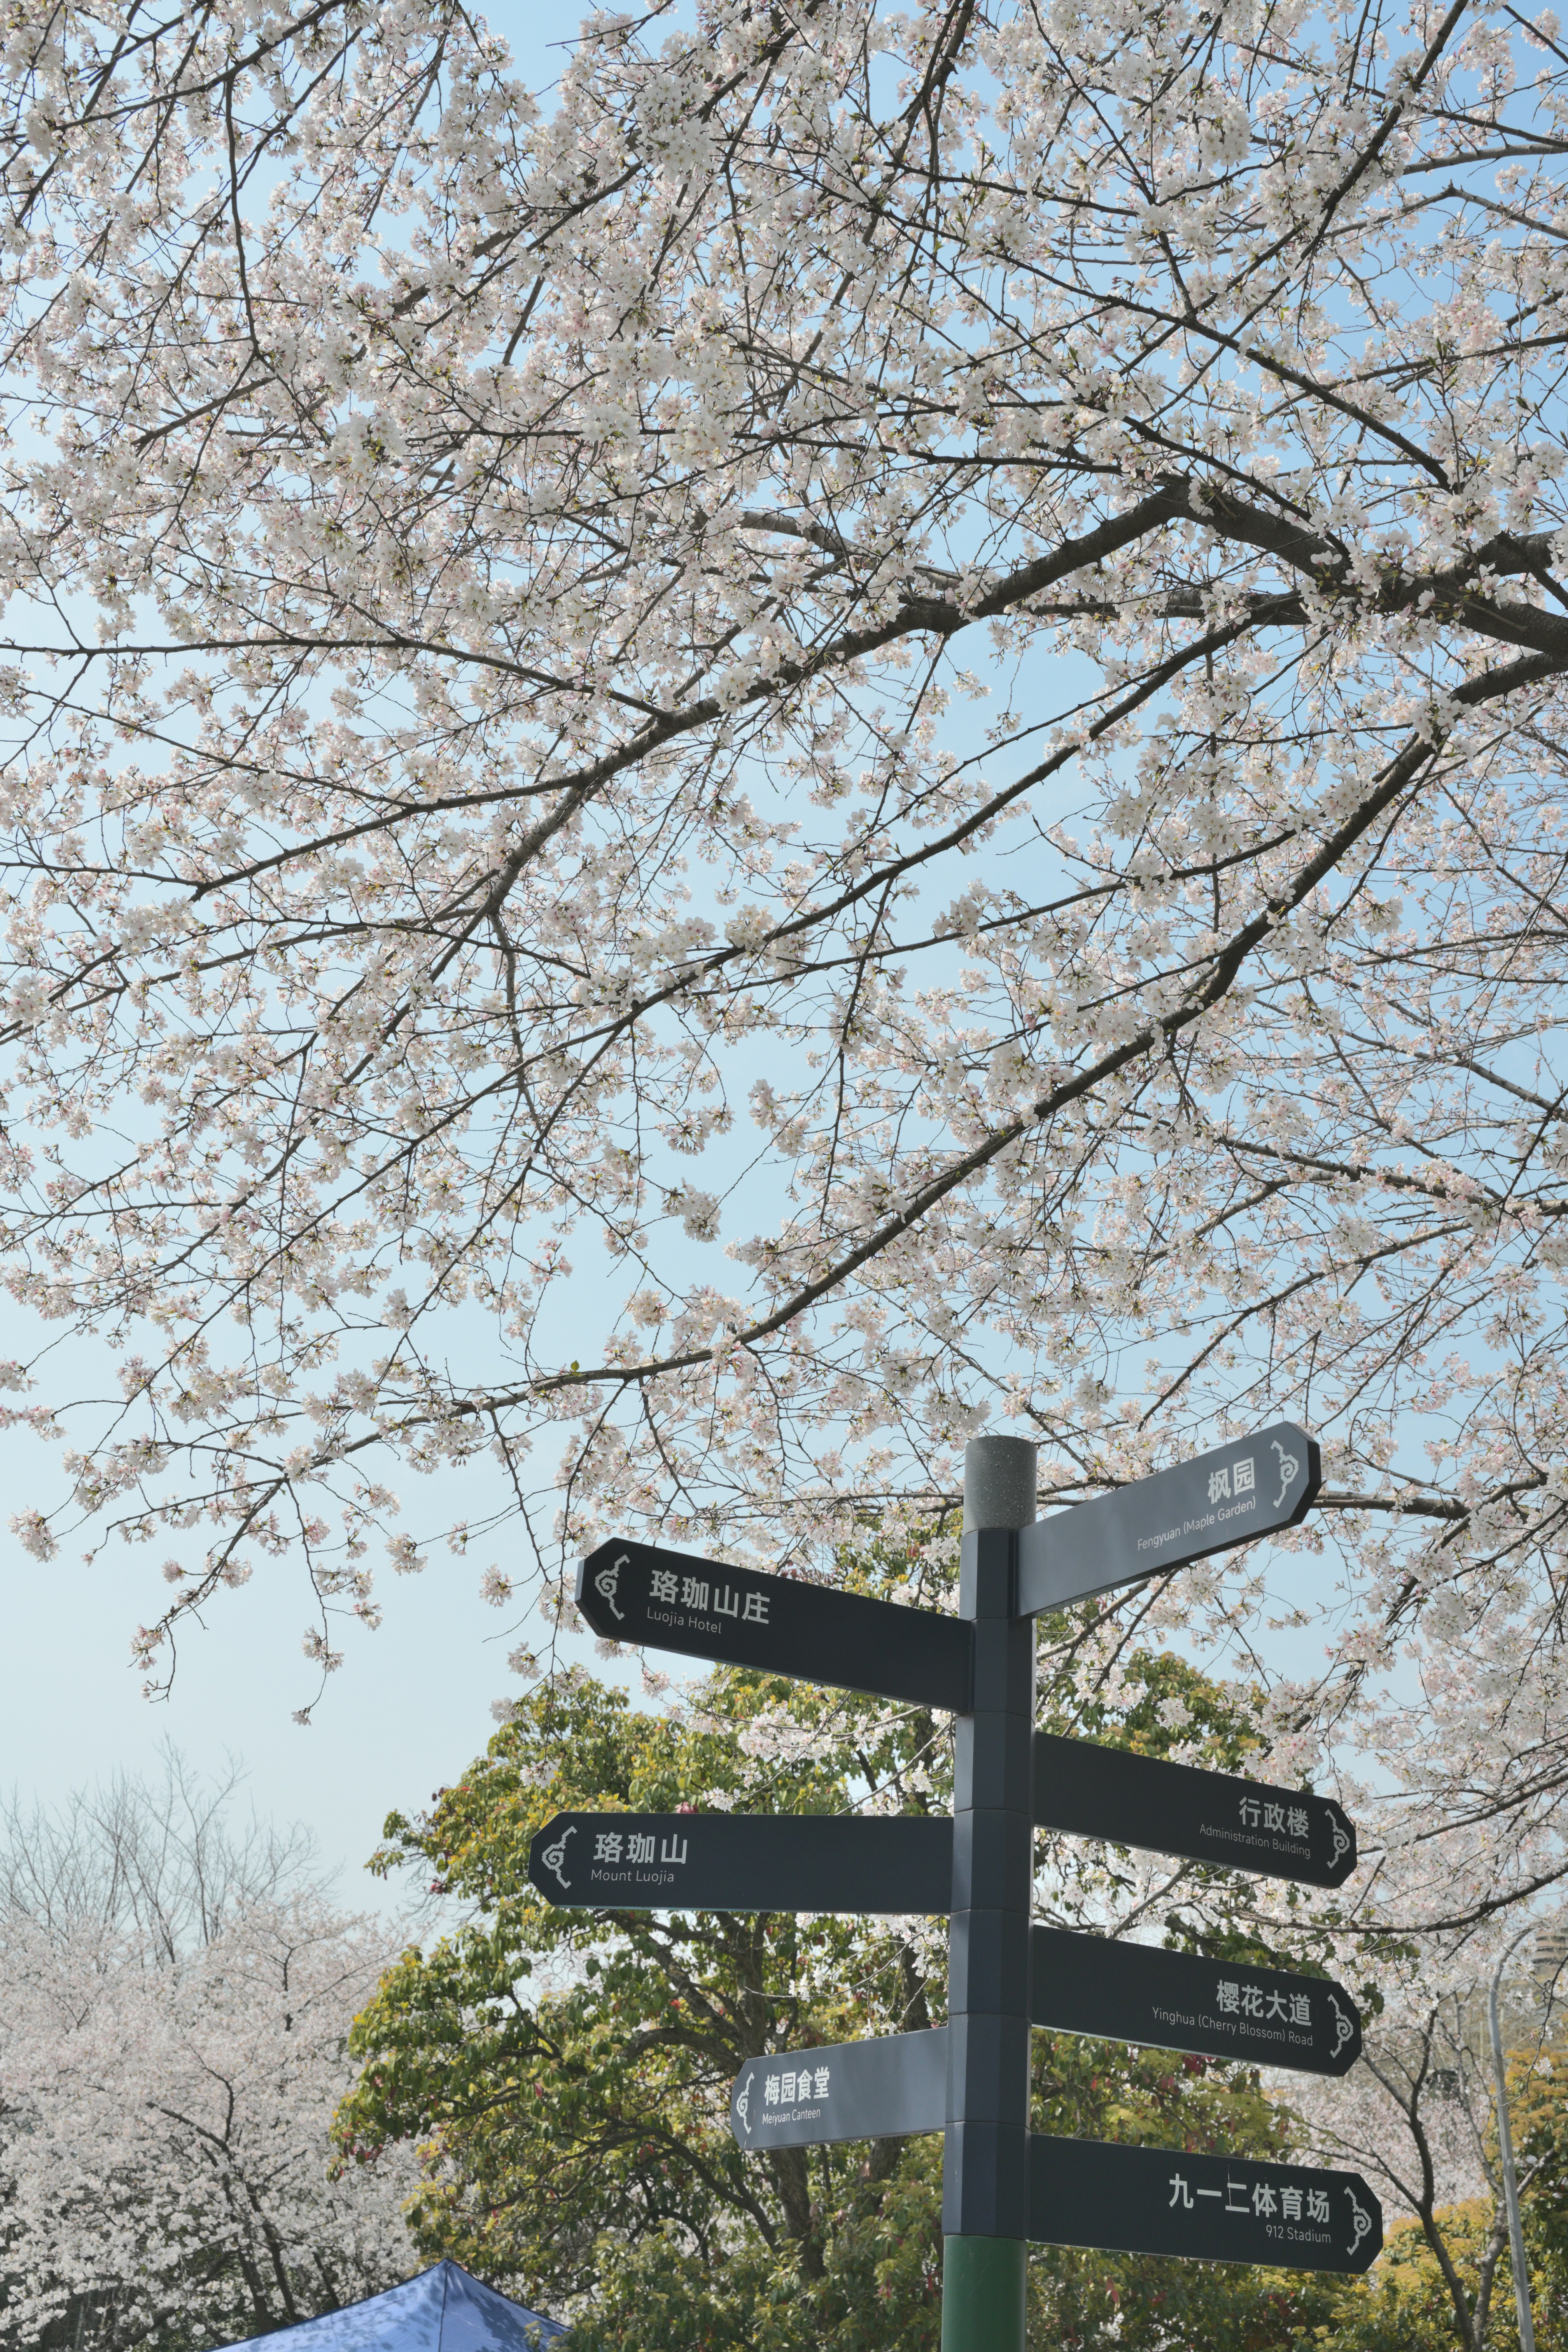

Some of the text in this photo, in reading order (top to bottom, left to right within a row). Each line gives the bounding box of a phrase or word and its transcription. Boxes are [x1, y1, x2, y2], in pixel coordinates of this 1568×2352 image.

[1208, 1457, 1255, 1504] 枫园
[1138, 1496, 1255, 1550] Fengyuan (Maple Garden)
[649, 1569, 771, 1624] 珞珈山庄
[647, 1606, 721, 1634] Luojia Hotel
[1239, 1796, 1309, 1839] 行政楼
[593, 1832, 688, 1864] 珞珈山
[1200, 1824, 1311, 1859] Administration Building
[591, 1869, 674, 1885] Mount Luojia
[1216, 1979, 1312, 2026] 樱花大道
[1152, 2007, 1313, 2046] Yinghua (Cherry Blossom) Road
[764, 2066, 830, 2105] 梅园食堂
[763, 2109, 821, 2126] Meiyuan Canteen
[1169, 2173, 1330, 2223] 九一二体育场
[1266, 2225, 1331, 2243] 912 Stadium
